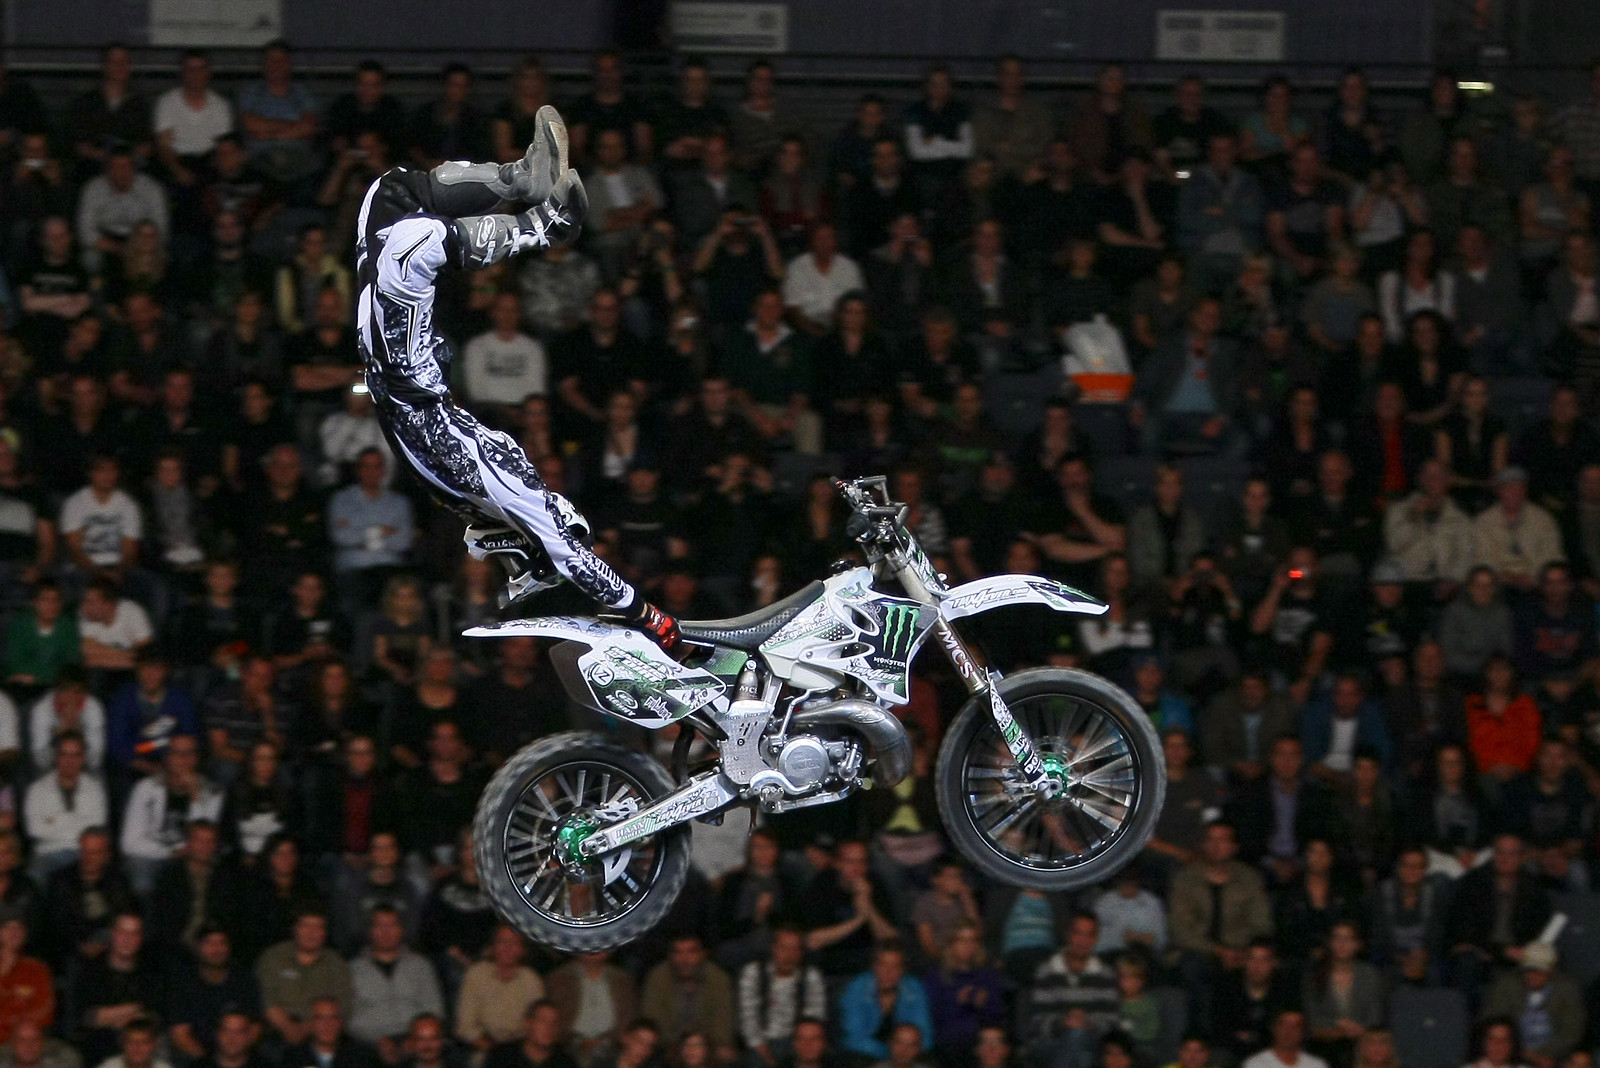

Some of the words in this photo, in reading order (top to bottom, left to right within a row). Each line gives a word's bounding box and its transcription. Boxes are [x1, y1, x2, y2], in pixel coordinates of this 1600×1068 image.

[873, 657, 906, 668] MONSTER
[938, 631, 973, 678] MCS
[606, 694, 636, 717] KENNY
